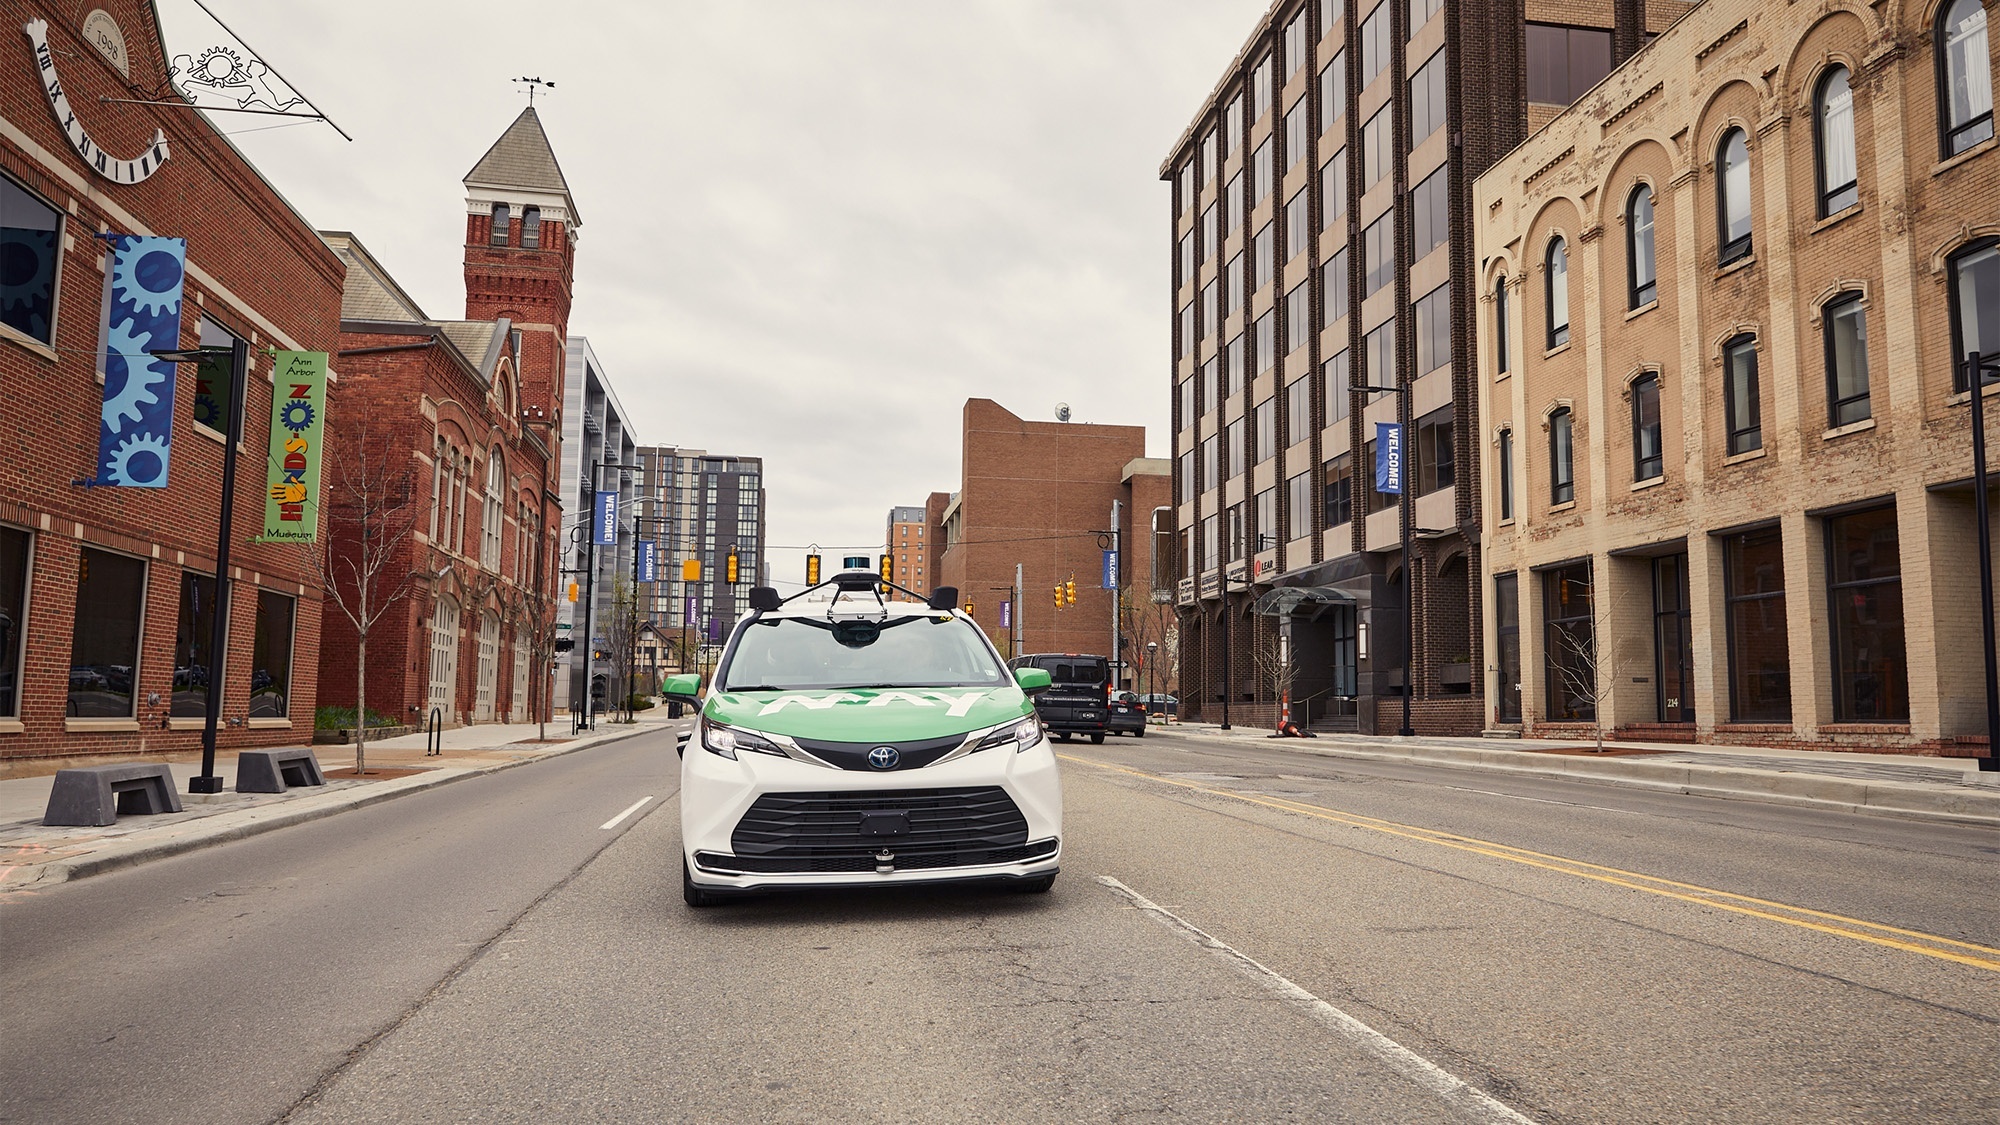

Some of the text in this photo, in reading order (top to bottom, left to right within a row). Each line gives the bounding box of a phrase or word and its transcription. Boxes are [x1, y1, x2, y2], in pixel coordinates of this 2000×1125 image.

[97, 30, 118, 60] 1998
[49, 80, 63, 103] IX
[64, 111, 75, 132] X
[79, 132, 91, 156] XI
[291, 356, 312, 366] Ann
[286, 366, 316, 376] Arbor
[1388, 427, 1399, 490] WELCOME!
[604, 494, 615, 542] WELCOME!
[267, 528, 312, 538] Museum
[1261, 560, 1274, 571] LEAR
[757, 692, 986, 717] MAY
[1667, 697, 1679, 708] 214
